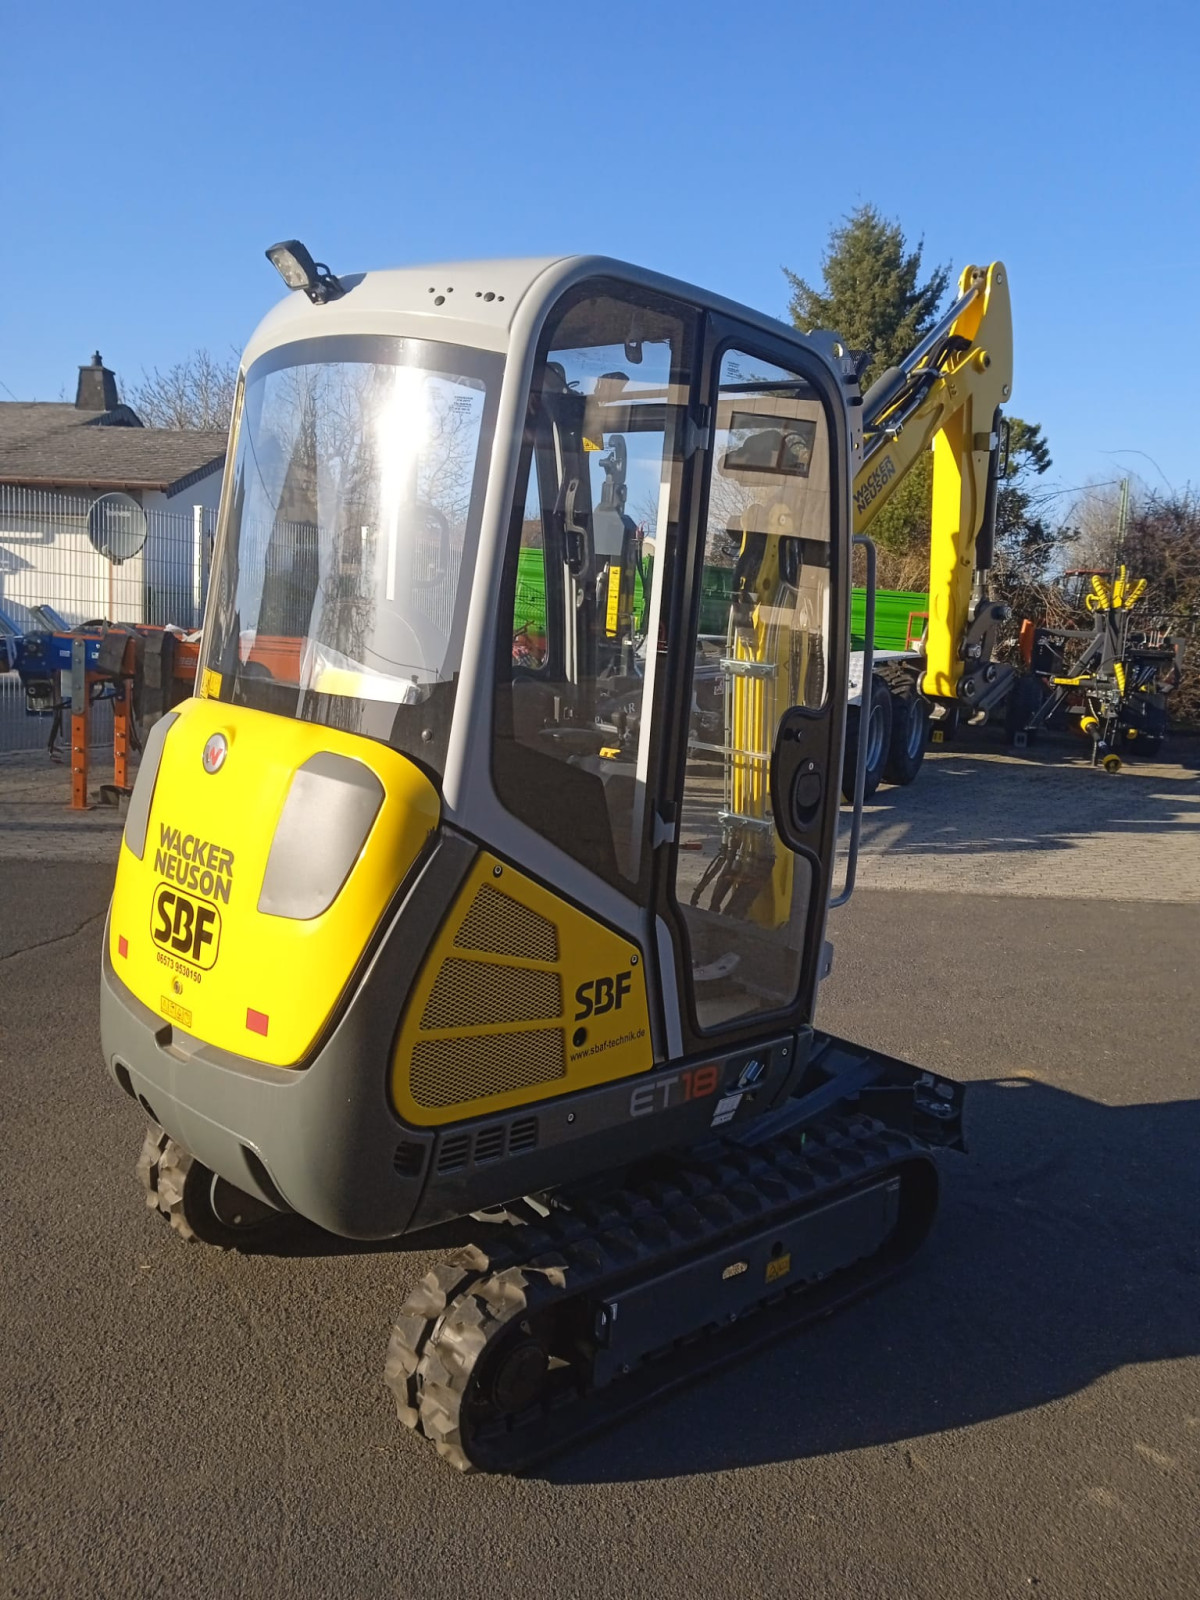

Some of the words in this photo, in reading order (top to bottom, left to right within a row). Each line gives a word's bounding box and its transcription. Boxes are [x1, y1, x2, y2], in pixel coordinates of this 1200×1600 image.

[853, 455, 894, 504] WACKER
[857, 468, 896, 515] NEUSON
[160, 822, 234, 878] WACKER
[154, 848, 232, 905] NEUSON
[154, 890, 216, 961] SBF
[156, 951, 175, 970] 06573
[574, 970, 632, 1022] SBF
[569, 1028, 646, 1062] www.sbaf-technik.de
[630, 1065, 718, 1117] ET18
